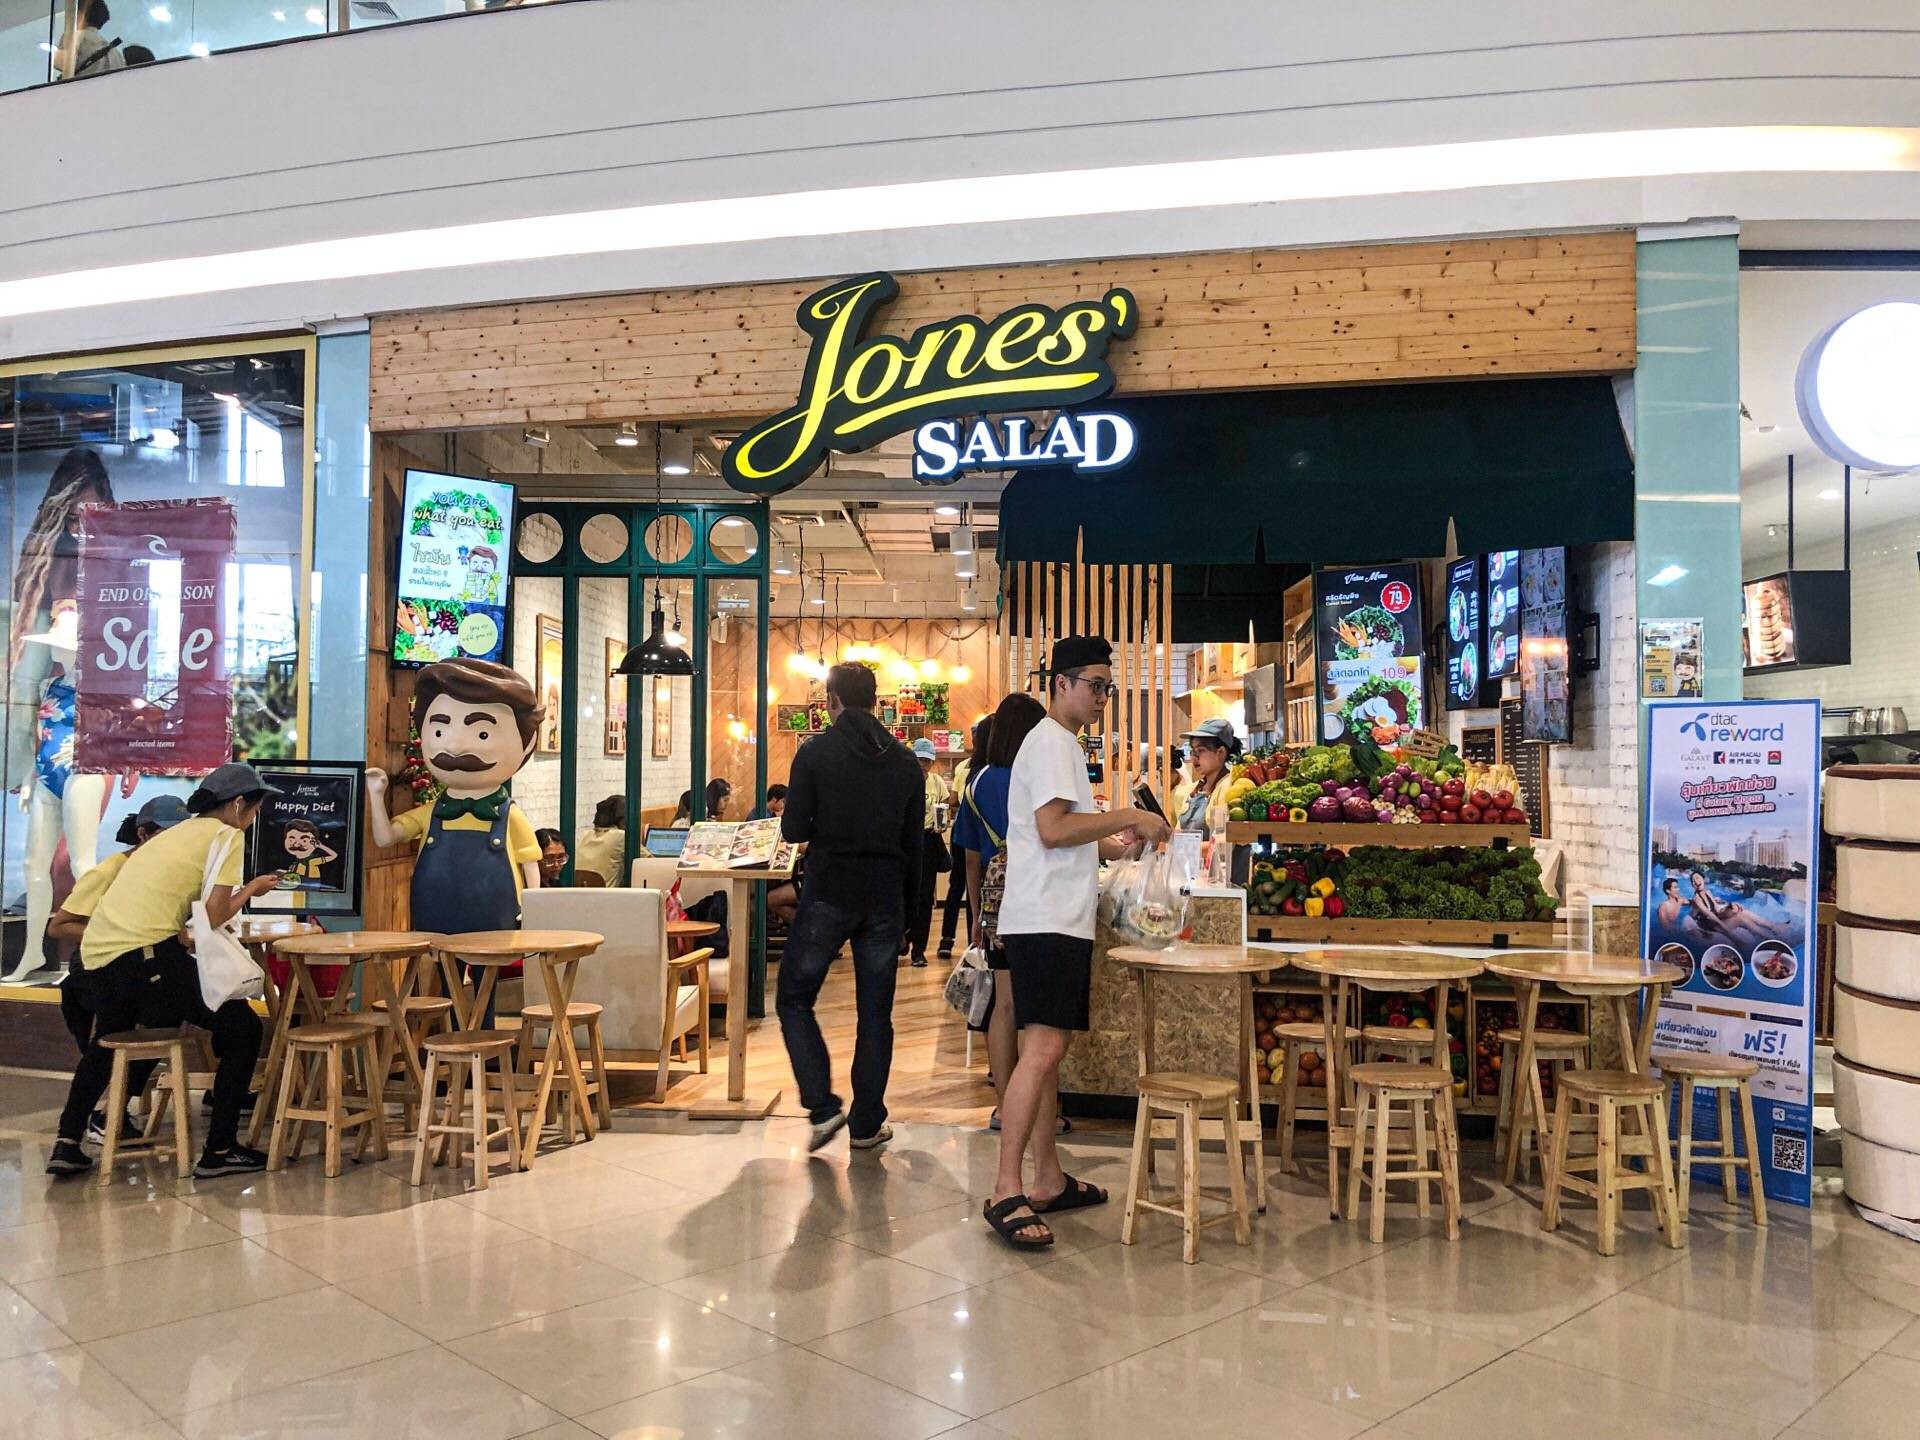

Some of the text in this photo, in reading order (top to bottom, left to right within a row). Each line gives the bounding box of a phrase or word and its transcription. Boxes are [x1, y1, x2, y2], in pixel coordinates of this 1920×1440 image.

[735, 279, 1128, 479] Jones'
[916, 413, 1135, 476] SALAD
[463, 494, 489, 507] are
[413, 506, 447, 523] what
[450, 515, 476, 530] you
[98, 588, 129, 601] END
[96, 613, 214, 671] Sae
[1710, 713, 1738, 726] dtac
[1710, 723, 1784, 742] reward
[275, 801, 335, 815] Happy Diet
